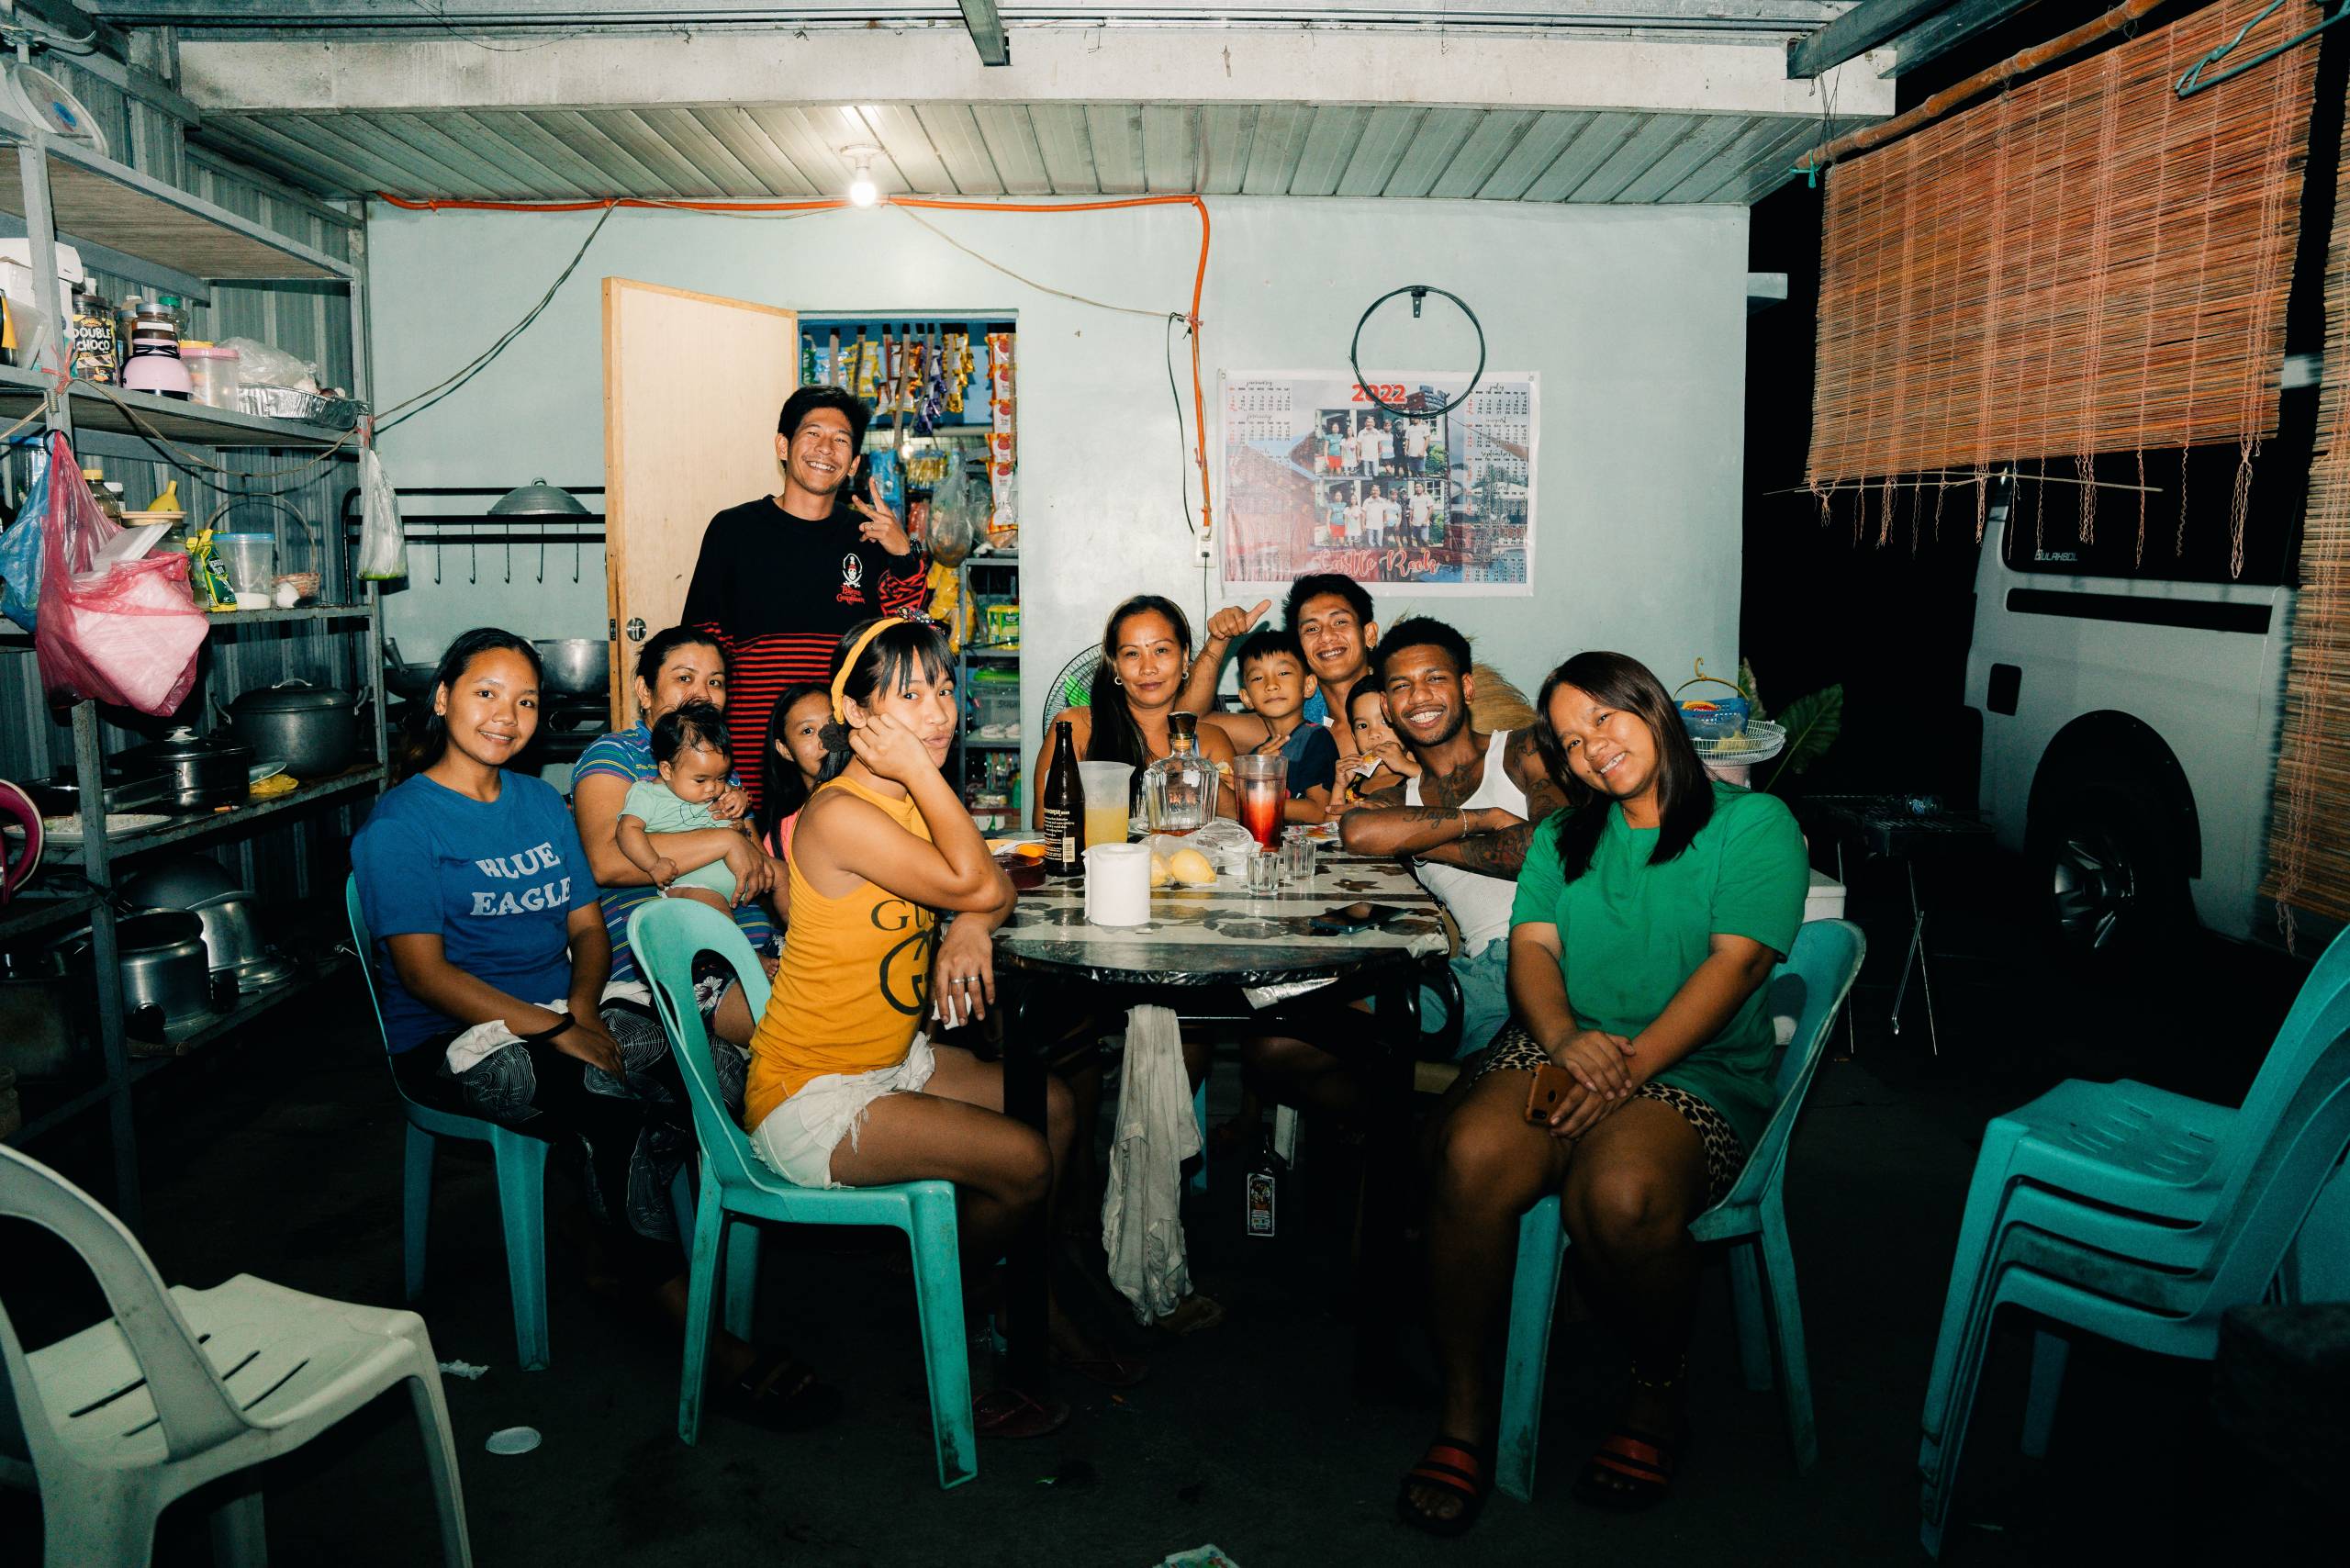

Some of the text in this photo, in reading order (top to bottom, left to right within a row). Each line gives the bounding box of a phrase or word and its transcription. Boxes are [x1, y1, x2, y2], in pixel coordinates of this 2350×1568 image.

[73, 327, 111, 339] DOUBLE
[76, 339, 110, 351] CHOCO
[1351, 383, 1407, 403] 2022
[476, 842, 561, 879] BLUE
[470, 877, 571, 916] EAGLE
